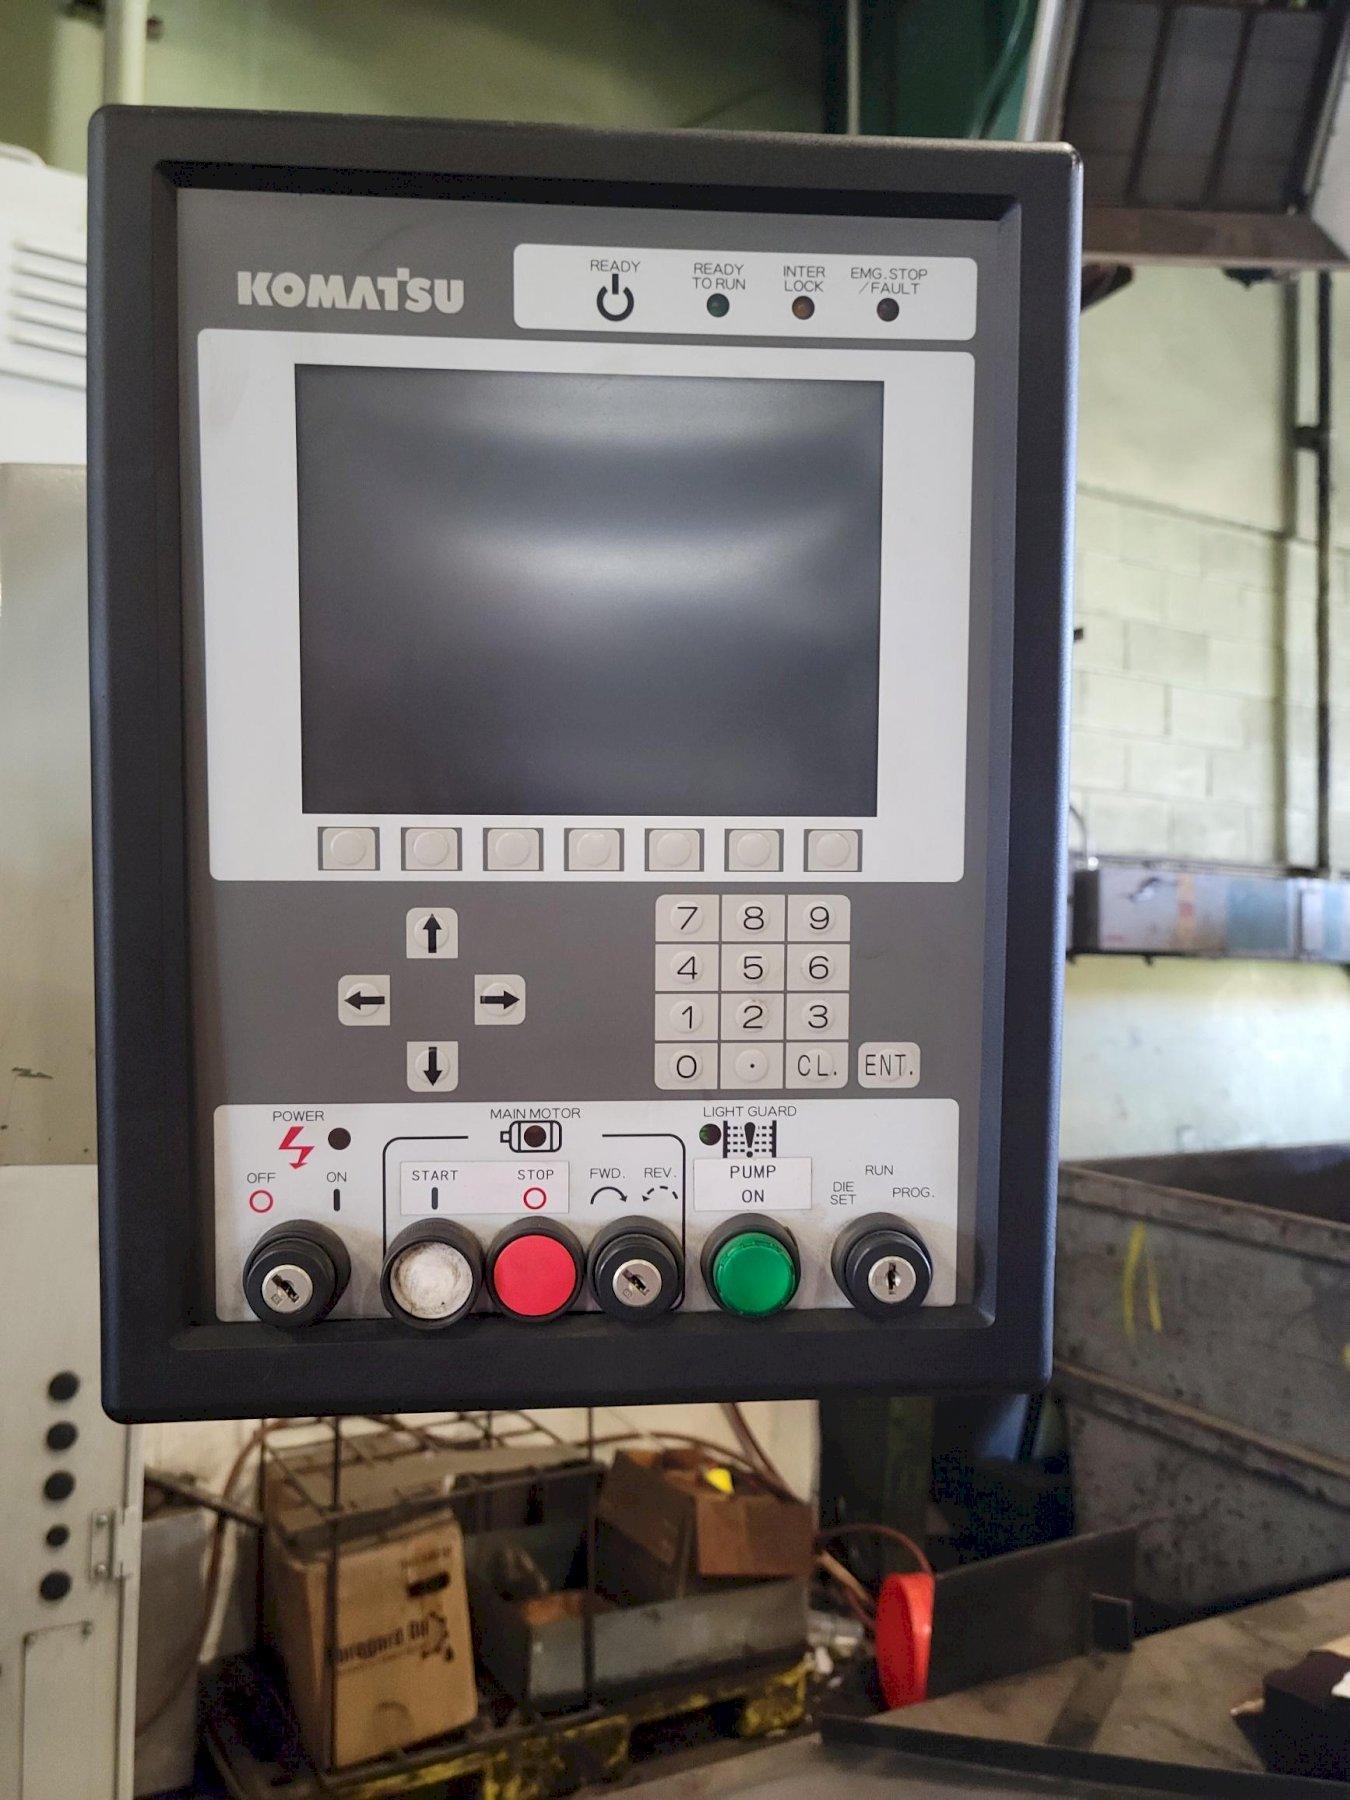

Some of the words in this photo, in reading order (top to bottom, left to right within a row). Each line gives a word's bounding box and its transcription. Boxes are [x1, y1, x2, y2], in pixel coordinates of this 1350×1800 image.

[589, 259, 642, 273] READY
[693, 262, 745, 276] READY
[782, 265, 826, 279] INTER
[237, 267, 465, 314] KOMATSU
[692, 276, 713, 290] TO
[715, 277, 747, 291] RUN
[783, 280, 825, 293] LOCK
[676, 906, 699, 930] 7
[743, 906, 765, 930] 8
[809, 906, 830, 930] 9
[676, 955, 698, 980] 4
[743, 955, 764, 980] 5
[808, 955, 829, 980] 6
[680, 1005, 693, 1030] 1
[742, 1005, 763, 1030] 2
[807, 1004, 829, 1029] 3
[676, 1054, 698, 1079] 0
[797, 1054, 839, 1077] CL.
[865, 1053, 914, 1077] ENT.
[272, 1110, 326, 1122] POWER
[489, 1108, 527, 1120] MAIN
[530, 1107, 582, 1120] MOTOR
[702, 1105, 744, 1118] LIGHT
[747, 1105, 798, 1118] GUARD
[326, 1171, 348, 1183] ON
[411, 1169, 459, 1182] START
[516, 1168, 555, 1182] STOP
[589, 1167, 627, 1180] FWD.
[643, 1167, 678, 1179] REV.
[729, 1164, 777, 1180] PUMP
[865, 1164, 895, 1176] RUN
[246, 1172, 277, 1184] OFF
[832, 1181, 855, 1193] DIE
[892, 1186, 936, 1198] PROG.
[741, 1189, 765, 1204] ON
[830, 1194, 857, 1206] SET
